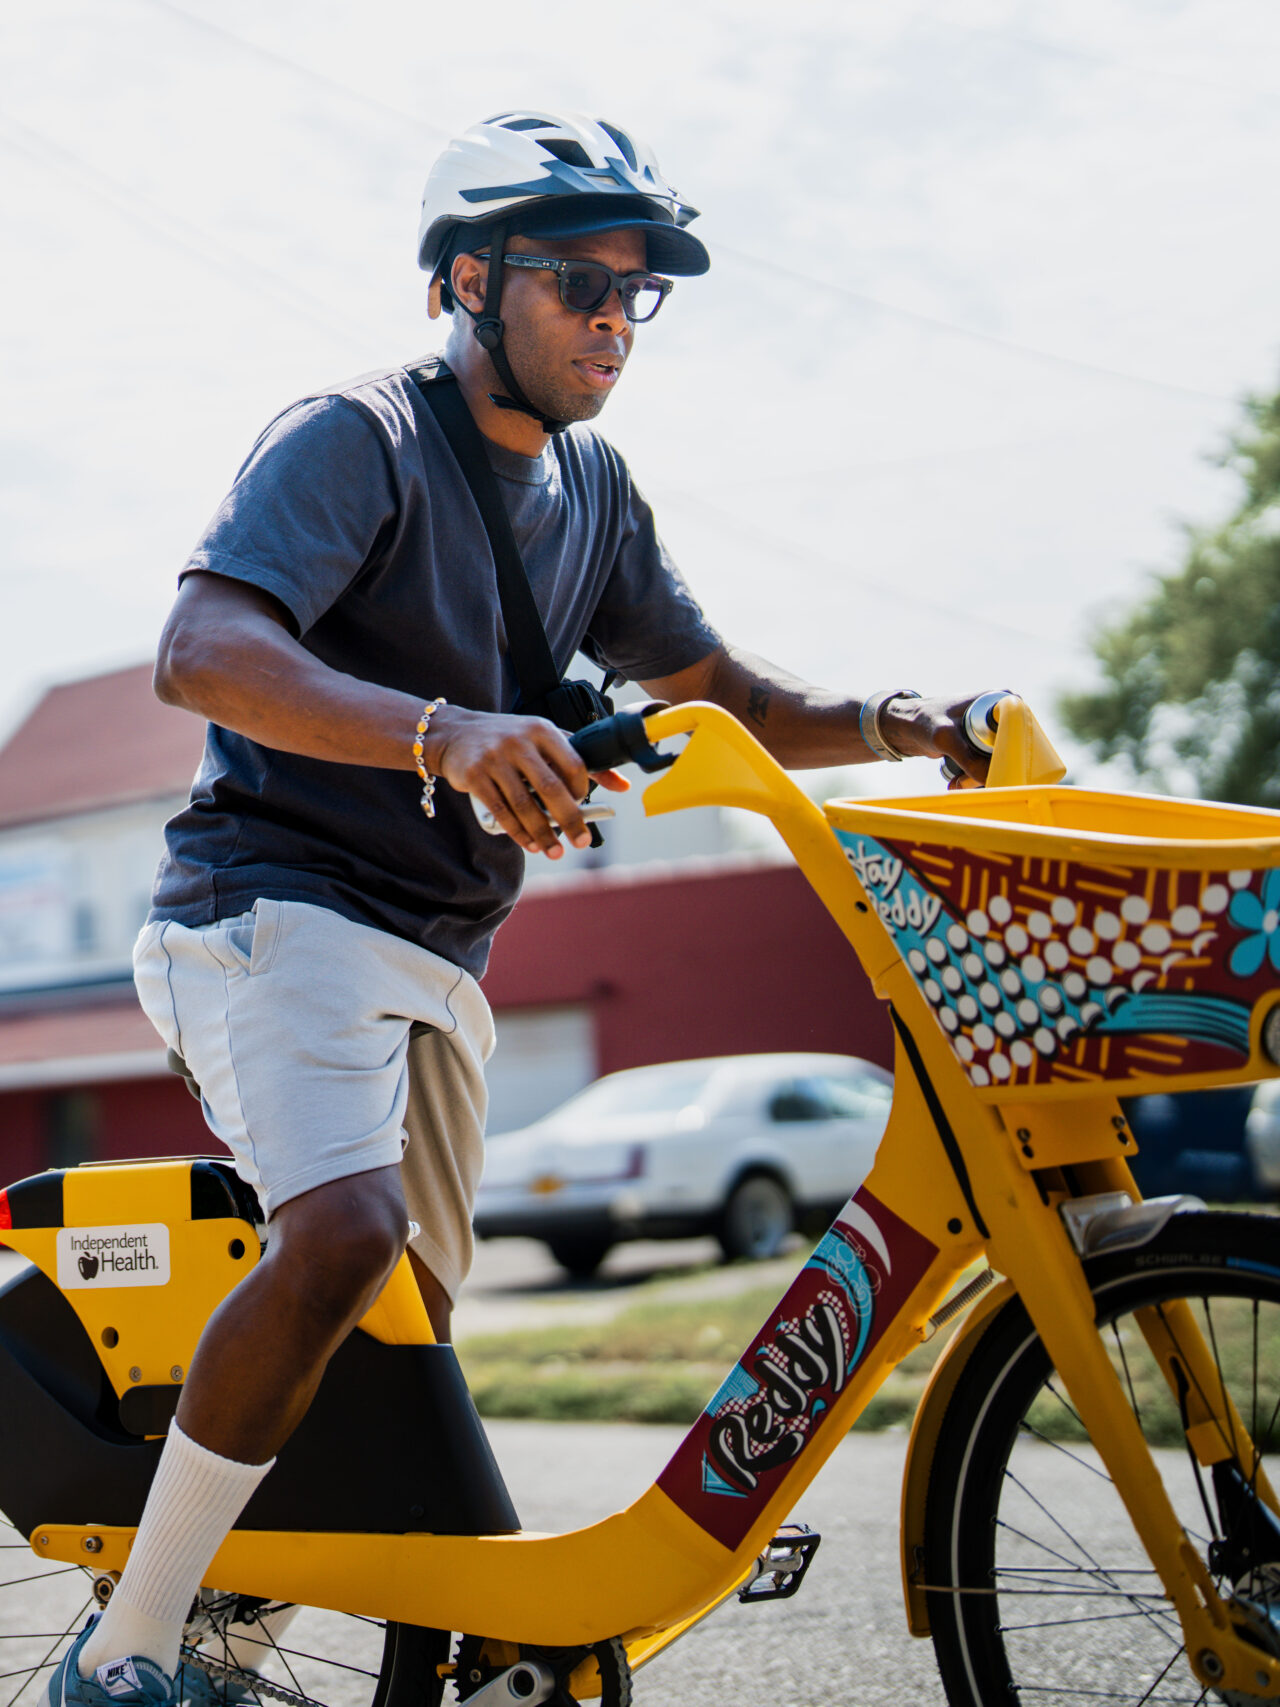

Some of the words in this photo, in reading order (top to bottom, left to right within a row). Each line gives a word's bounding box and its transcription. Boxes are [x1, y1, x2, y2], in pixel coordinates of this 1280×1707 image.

[70, 1232, 148, 1254] Independent
[709, 1303, 847, 1491] Reddy
[107, 1662, 128, 1679] NIKE
